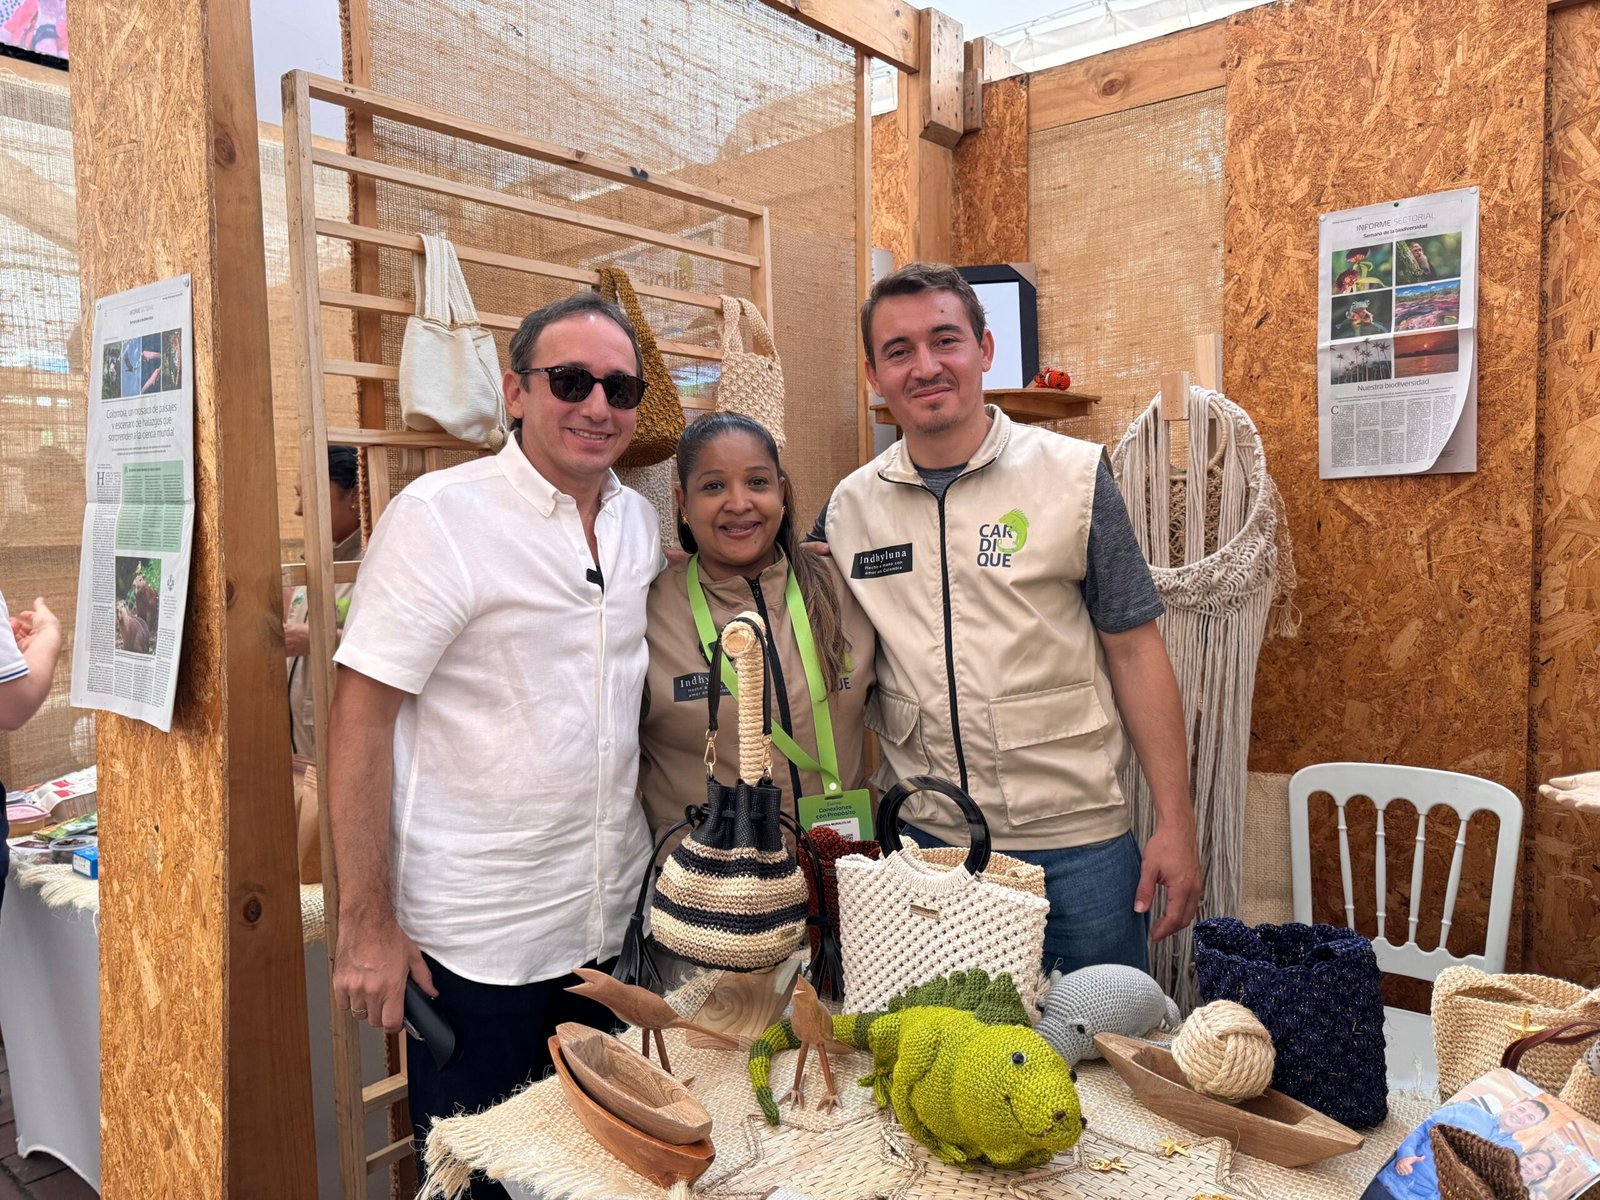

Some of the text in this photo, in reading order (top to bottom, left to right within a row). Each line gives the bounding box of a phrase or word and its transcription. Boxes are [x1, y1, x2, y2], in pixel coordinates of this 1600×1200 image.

[1356, 220, 1391, 232] INFORME
[1394, 212, 1436, 226] SECTORIAL
[1396, 224, 1428, 234] biodiversidad
[1358, 378, 1430, 392] Nuestra biodiversidad
[159, 403, 177, 415] paisajes
[979, 524, 1012, 538] CAR
[979, 538, 997, 552] DI
[860, 550, 907, 564] Indhyluna
[977, 552, 1012, 568] QUE
[680, 674, 709, 688] Indhy
[818, 805, 852, 813] Conexiones
